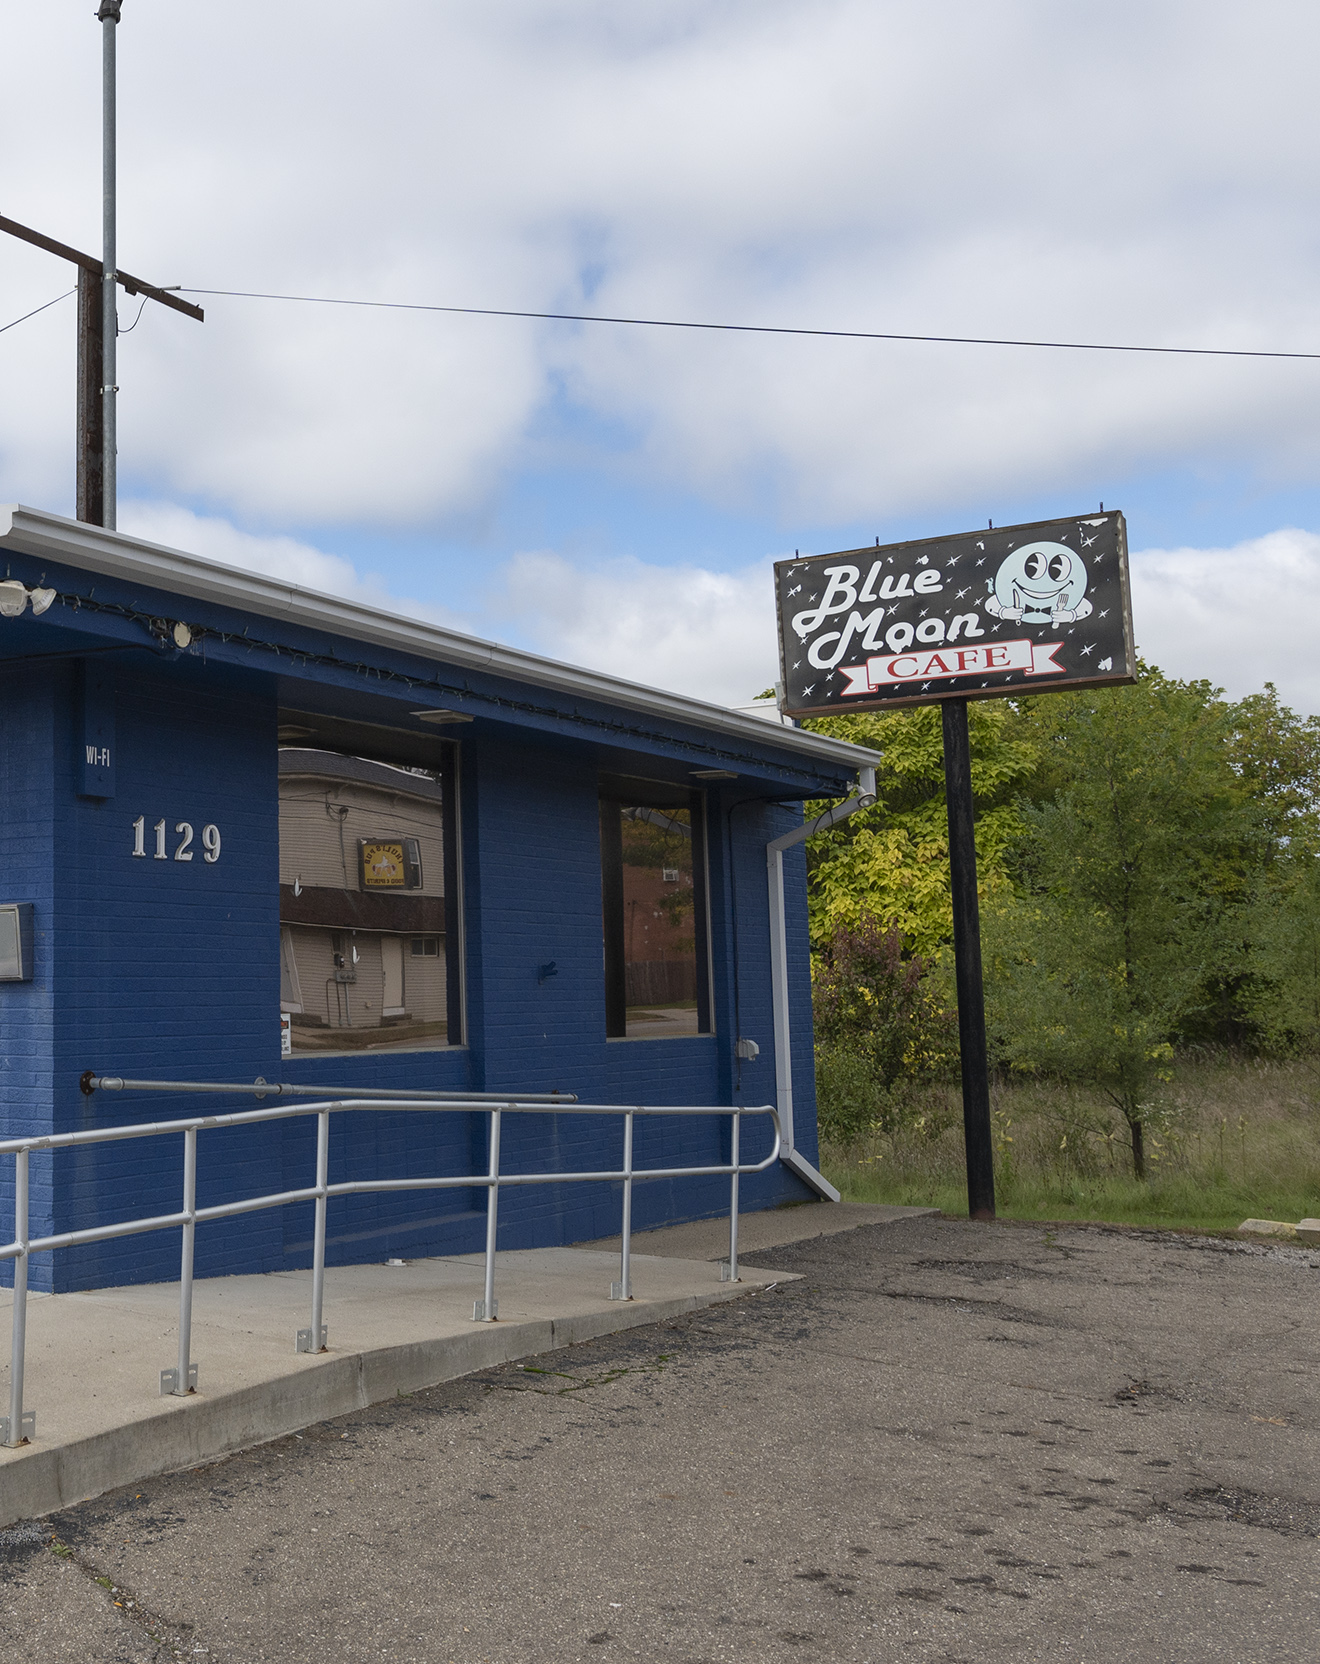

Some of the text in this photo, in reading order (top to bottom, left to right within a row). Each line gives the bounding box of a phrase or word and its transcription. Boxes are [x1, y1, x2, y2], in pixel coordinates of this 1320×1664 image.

[792, 561, 944, 638] Blue
[808, 608, 985, 670] Moon
[887, 646, 1012, 679] CAFE
[86, 745, 110, 767] WI-FI
[132, 815, 221, 863] 1129
